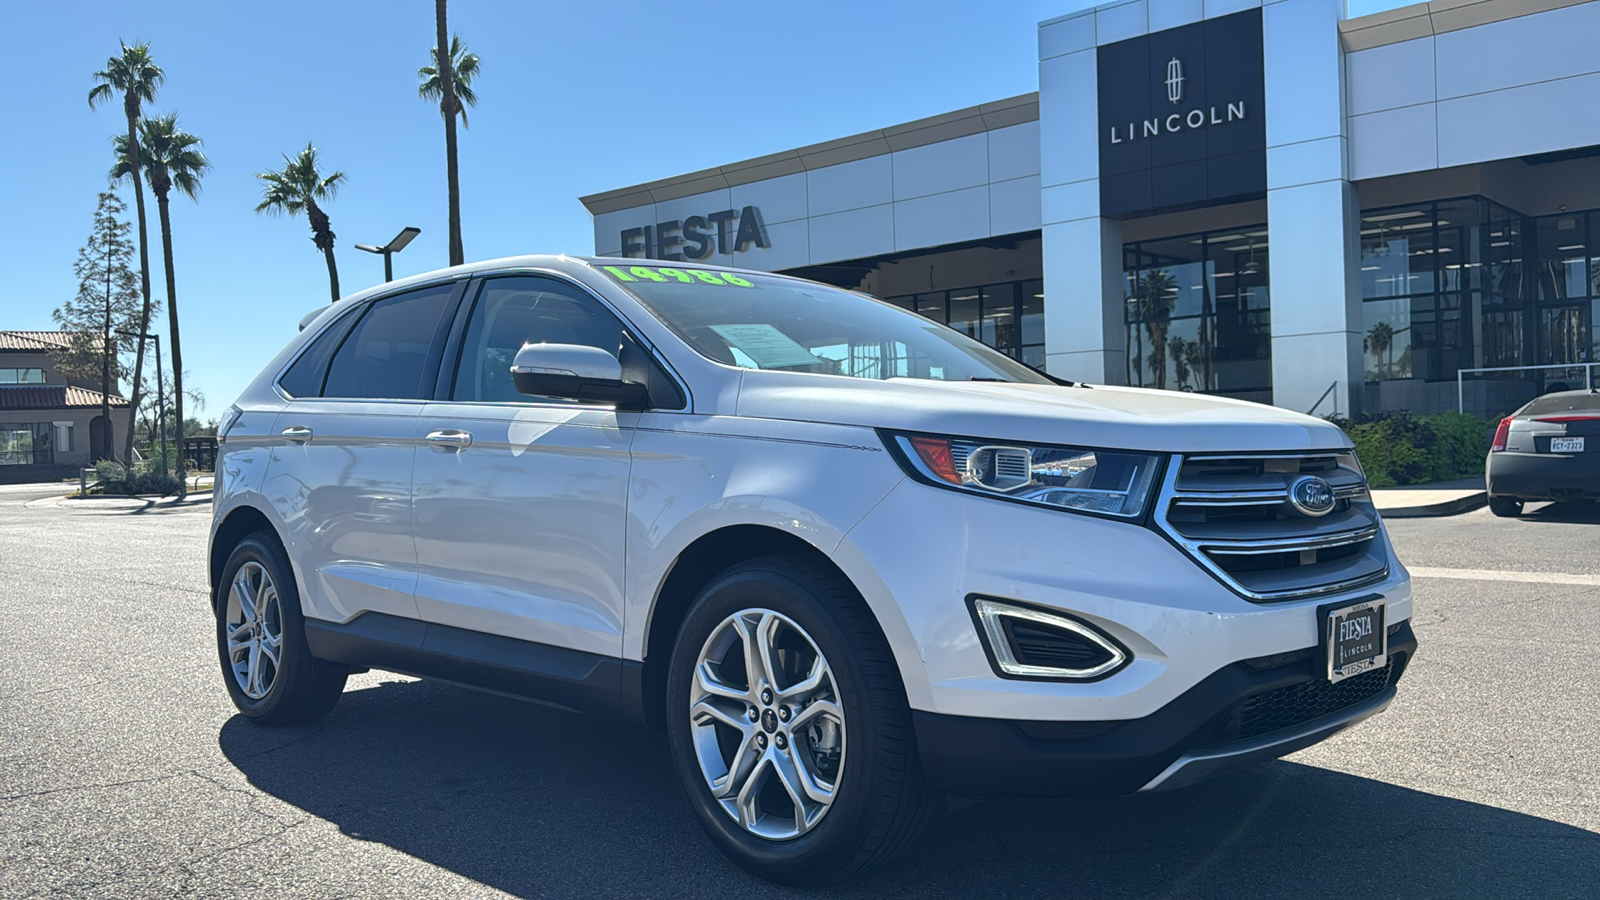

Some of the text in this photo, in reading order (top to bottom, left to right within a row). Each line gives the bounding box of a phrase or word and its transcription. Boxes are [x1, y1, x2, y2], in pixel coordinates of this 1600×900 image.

[1111, 101, 1245, 144] LINCOLN
[620, 205, 772, 261] FIESTA
[603, 266, 755, 288] 14986
[1340, 615, 1373, 642] FIESTA
[1344, 642, 1373, 658] LINCOLN
